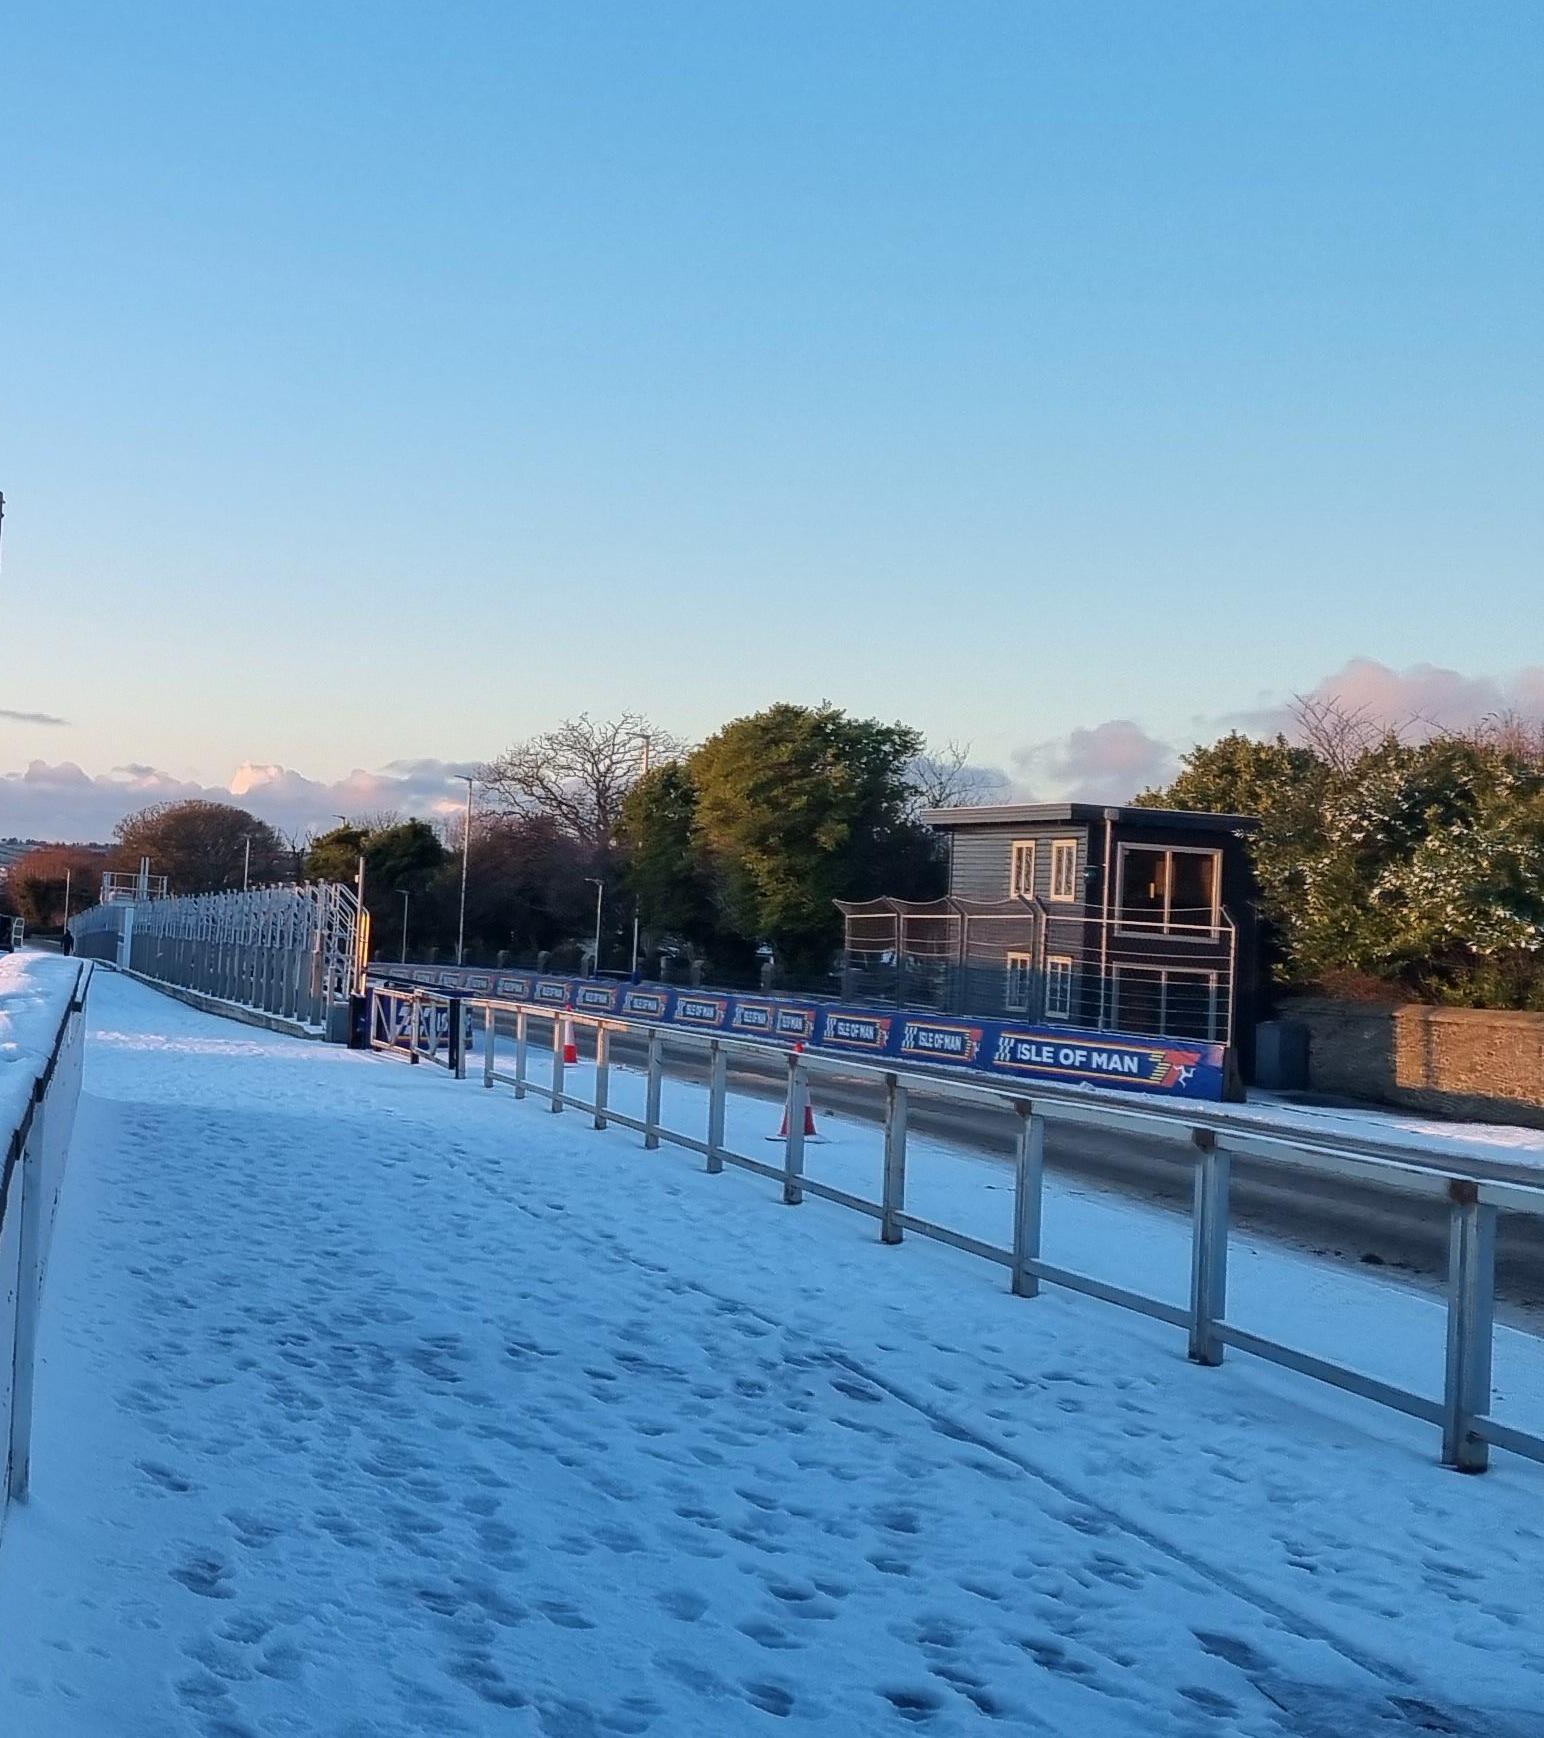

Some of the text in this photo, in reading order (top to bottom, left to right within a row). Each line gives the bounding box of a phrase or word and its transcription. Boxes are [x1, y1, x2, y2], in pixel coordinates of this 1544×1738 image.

[919, 1031, 962, 1051] ISLE OF MAN
[1017, 1043, 1139, 1074] ISLE OF MAN
